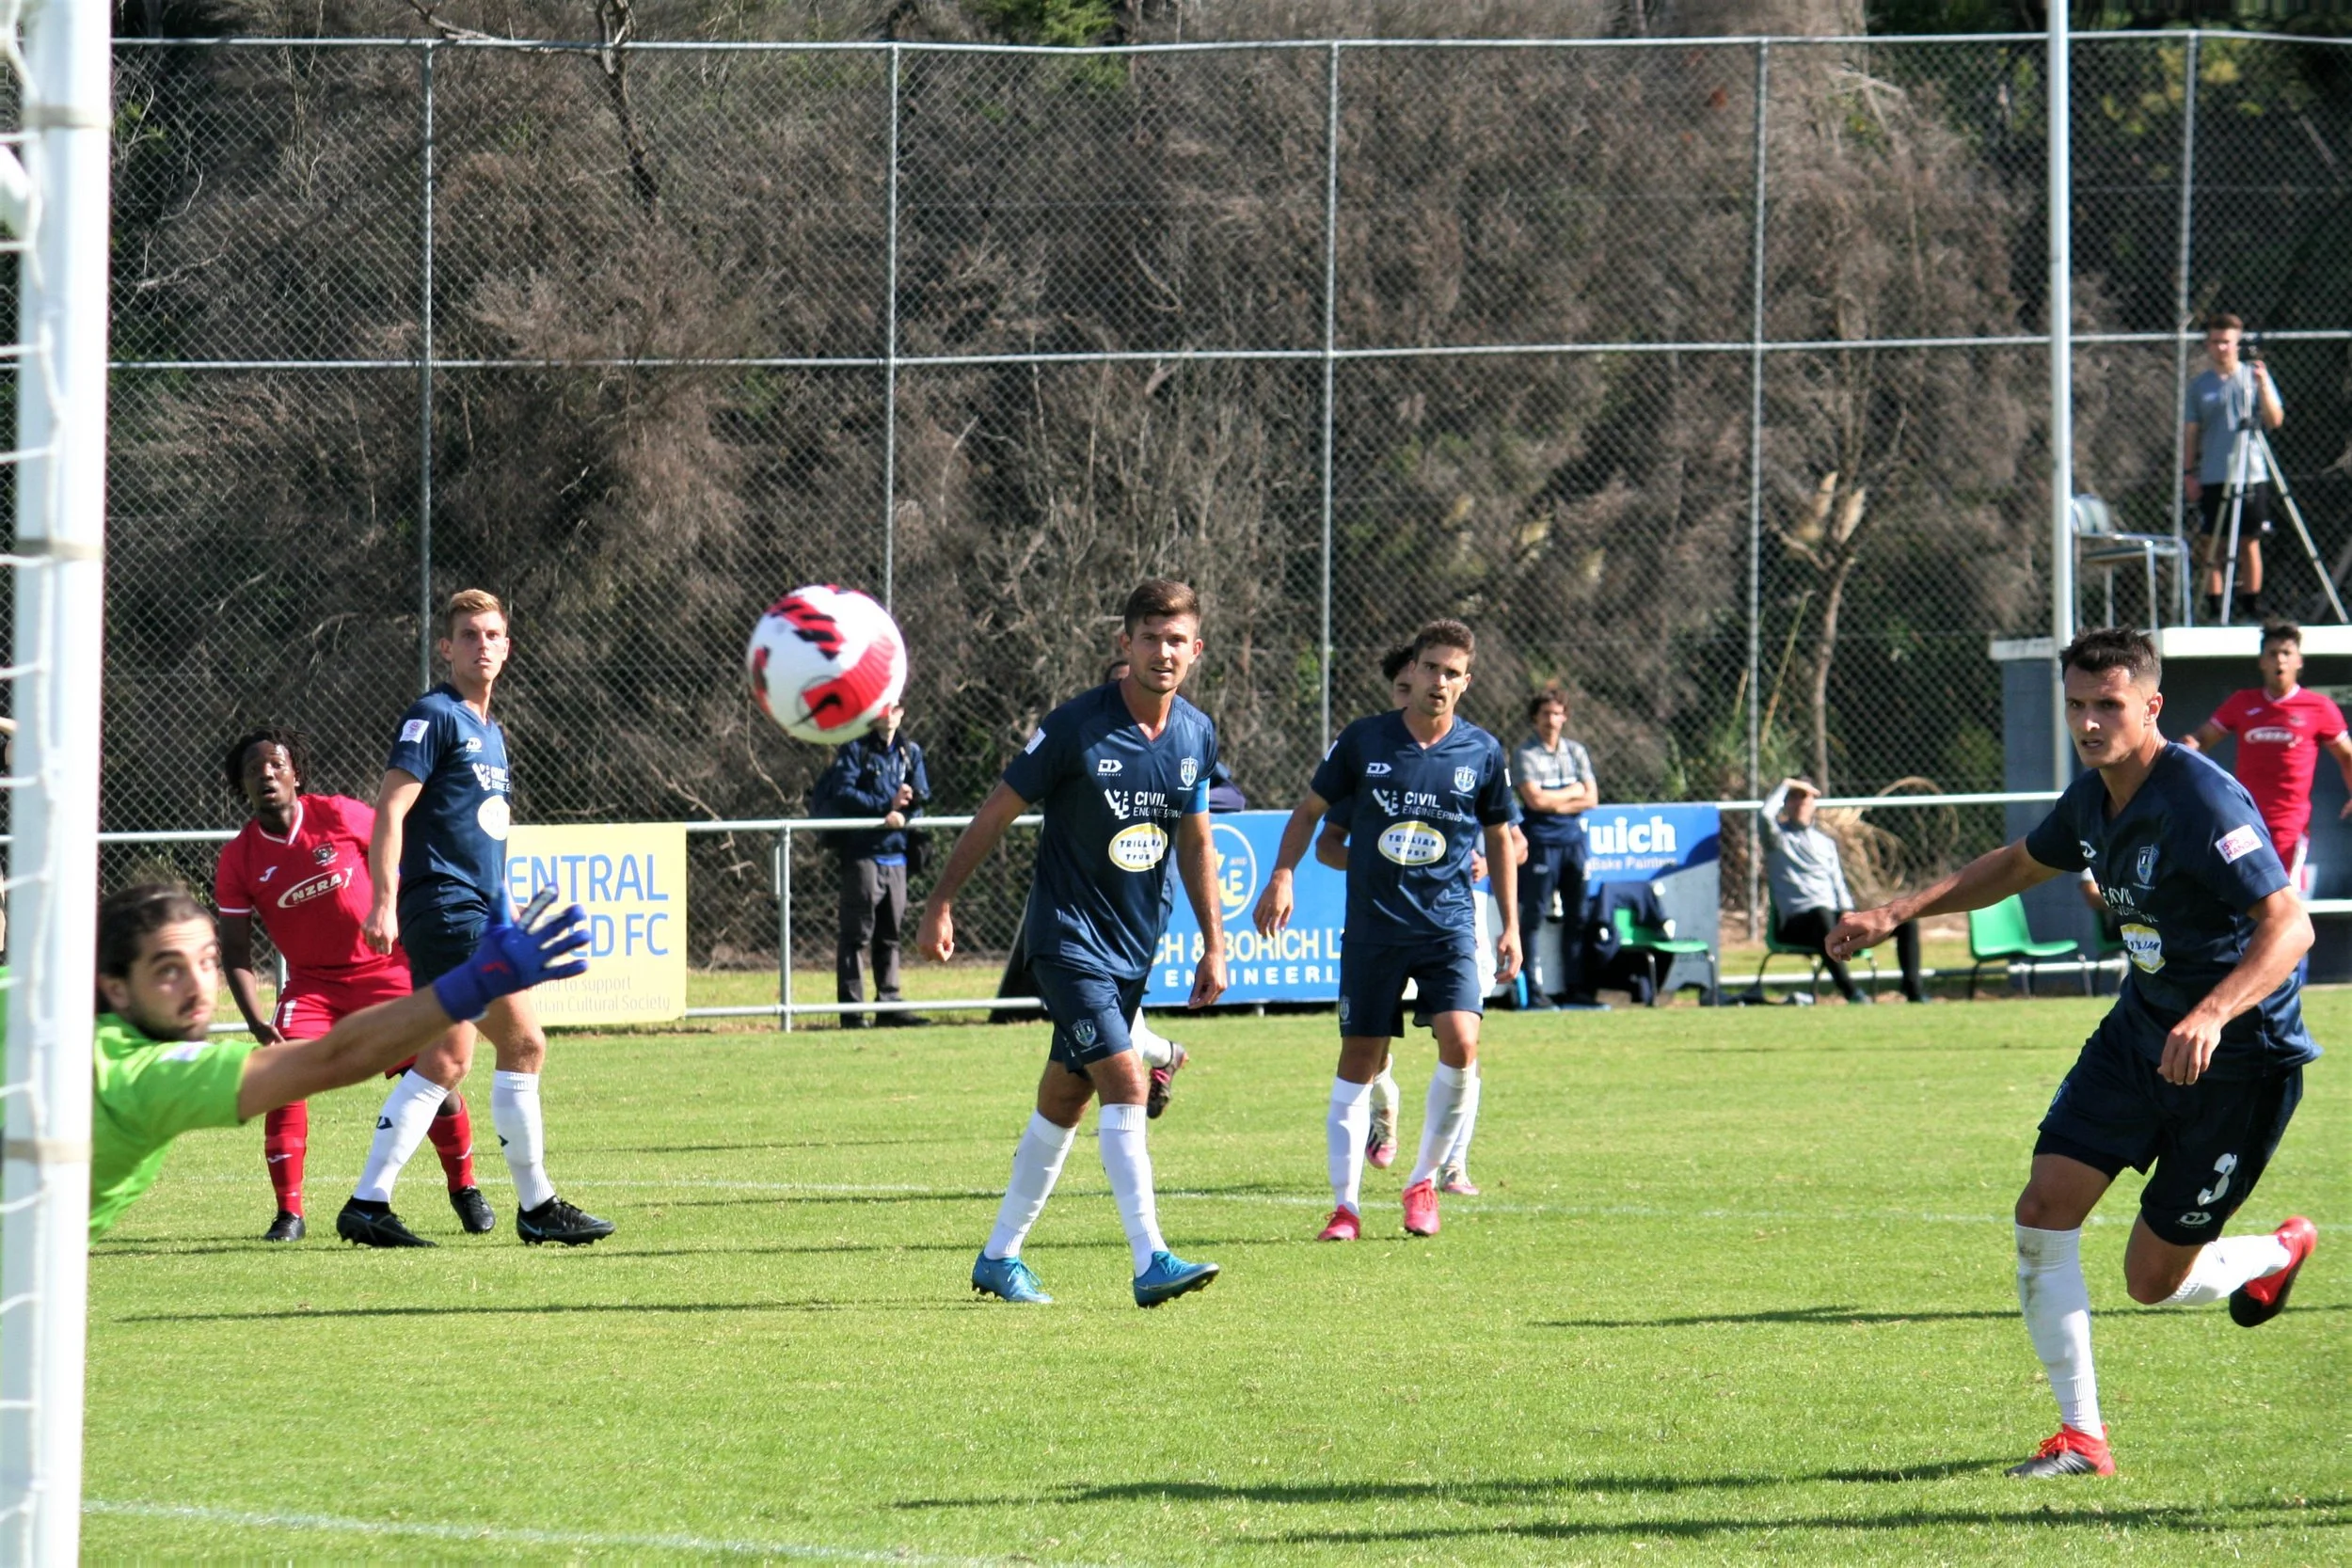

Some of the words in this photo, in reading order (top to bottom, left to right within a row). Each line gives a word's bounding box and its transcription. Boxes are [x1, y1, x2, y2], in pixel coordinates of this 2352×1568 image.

[1135, 791, 1168, 807] CIVIL
[1404, 791, 1440, 808] CIVIL
[1402, 805, 1463, 822] ENGINEERING
[1580, 815, 1677, 855] uich
[292, 873, 342, 902] NZRA
[625, 912, 669, 957] FC
[581, 975, 631, 995] support
[567, 995, 619, 1012] Cultural
[622, 993, 671, 1011] Society
[2198, 1153, 2237, 1206] 3
